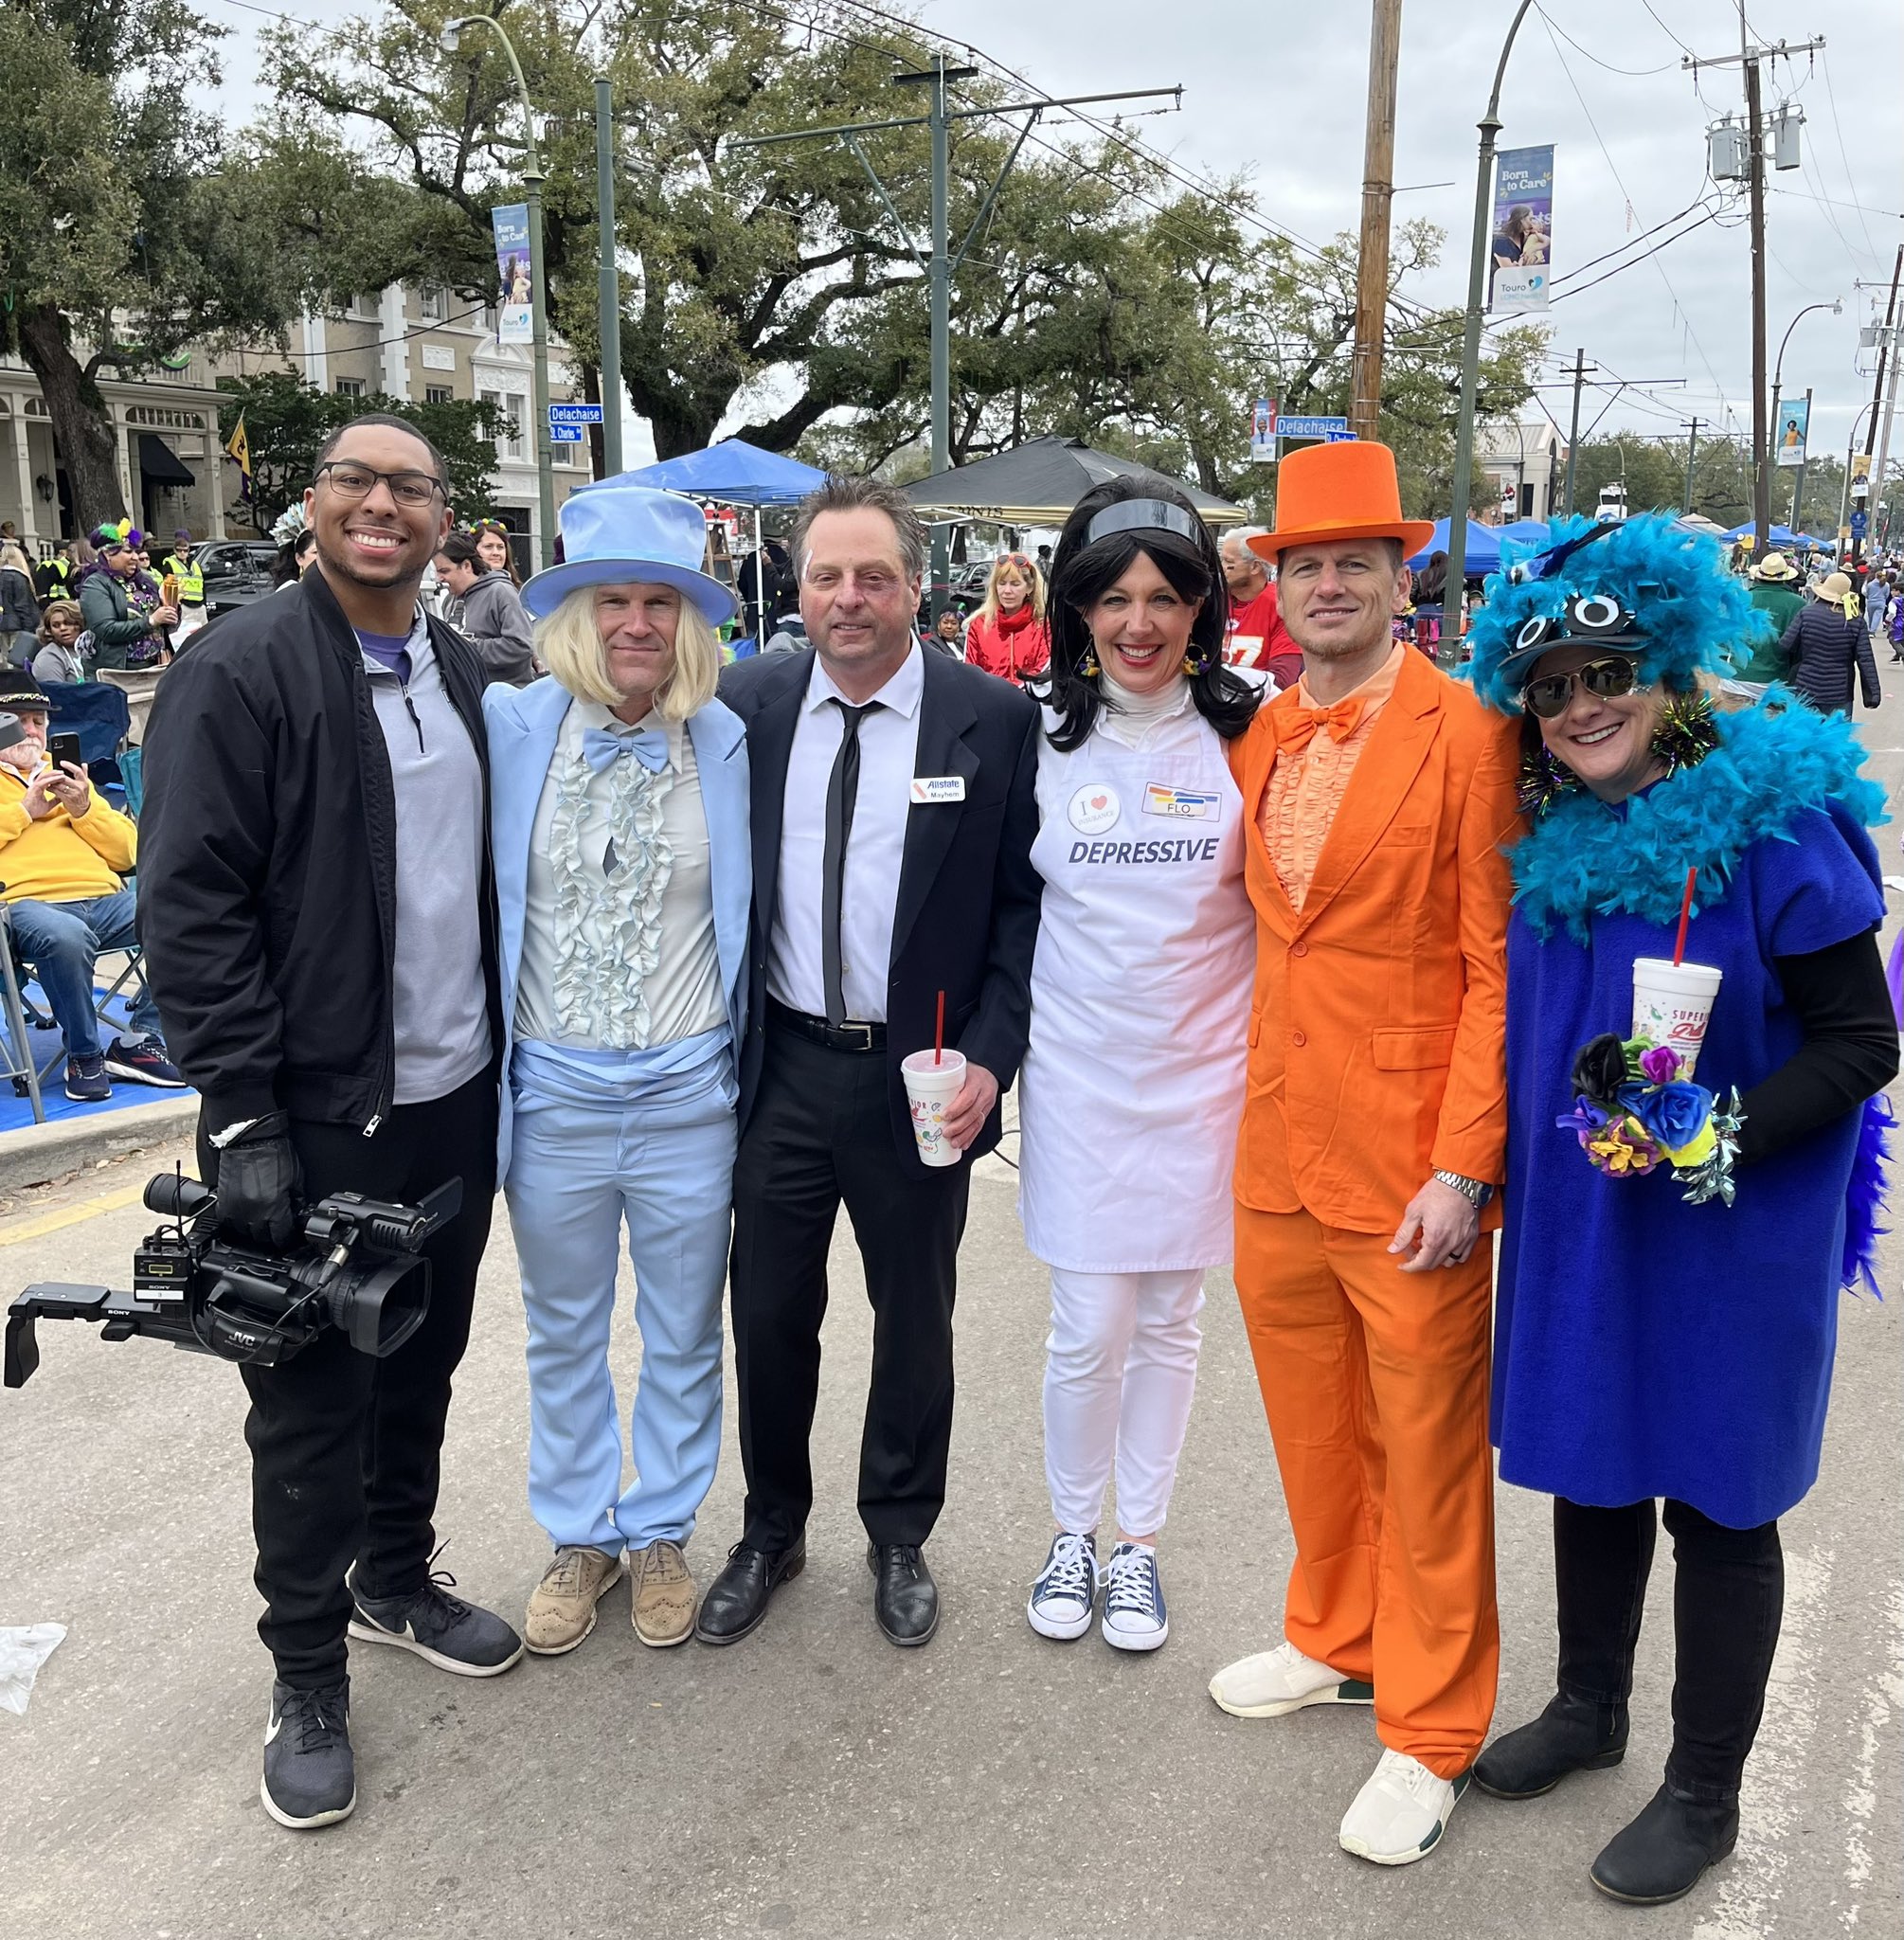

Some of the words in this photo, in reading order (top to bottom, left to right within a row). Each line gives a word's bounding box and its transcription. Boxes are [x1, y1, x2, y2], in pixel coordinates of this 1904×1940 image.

[1501, 171, 1529, 181] Born
[1507, 181, 1518, 191] to
[1518, 178, 1547, 189] Care
[1501, 283, 1527, 292] Touro
[551, 407, 600, 421] Delachaise
[1277, 419, 1343, 434] Delachaise
[927, 780, 960, 789] Allstate
[1080, 800, 1087, 816] I
[1167, 803, 1191, 814] FLO
[1069, 837, 1220, 864] DEPRESSIVE
[228, 1331, 256, 1347] JVC
